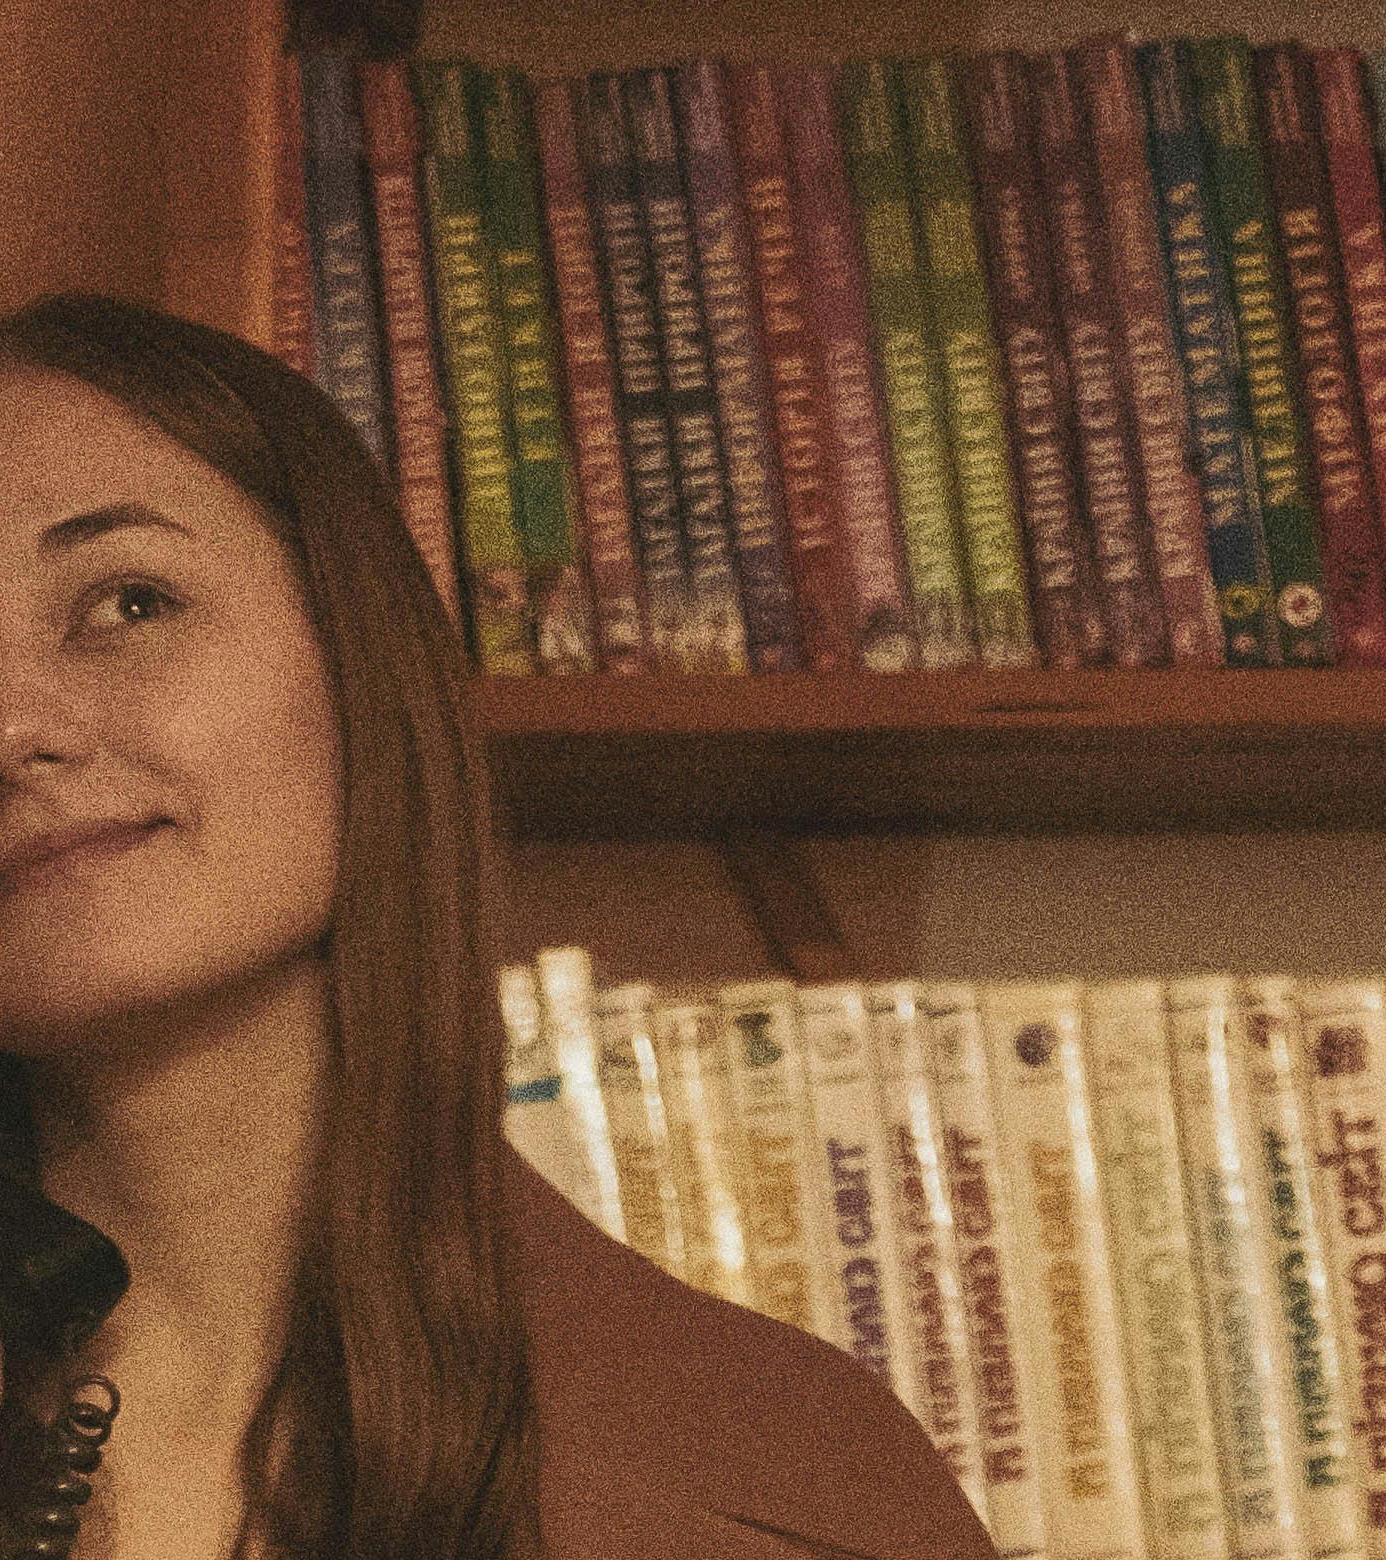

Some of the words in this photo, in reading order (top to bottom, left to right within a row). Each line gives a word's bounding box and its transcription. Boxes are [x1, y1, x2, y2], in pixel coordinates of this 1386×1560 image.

[744, 173, 806, 337] РЕЧЕЙ
[496, 247, 562, 464] ЕТИКЕТ
[694, 201, 779, 551] ІНФОРМАТИКА
[1006, 322, 1059, 438] СВІТУ
[1067, 315, 1121, 431] СВІТУ
[1124, 311, 1179, 427] СВІТУ
[1162, 178, 1247, 528] МАТЕМАТИКА
[1228, 216, 1305, 509] МЕДИЦИНА
[1281, 203, 1364, 513] МІФОЛОГІЯ
[629, 412, 688, 583] ЗАГАДКИ
[674, 409, 734, 582] ЗАГАДКИ
[770, 350, 834, 553] ІСТОРІЯ
[1019, 440, 1079, 590] КРАЇНИ
[1082, 434, 1142, 585] КРАЇНИ
[1138, 429, 1199, 581] КРАЇНИ
